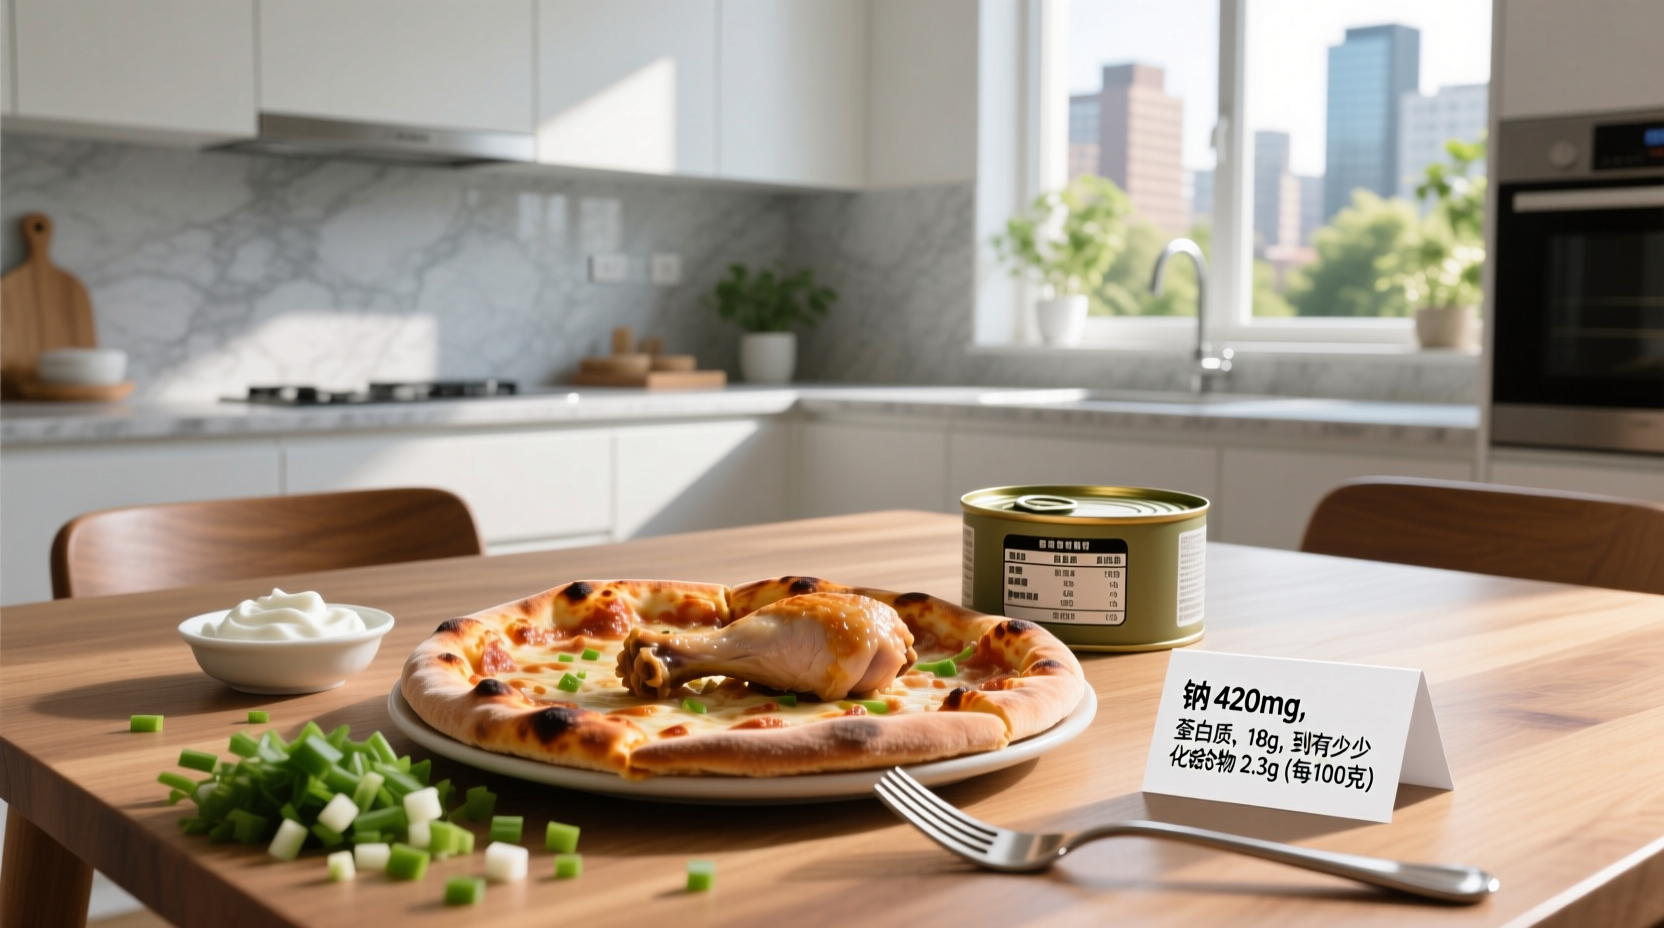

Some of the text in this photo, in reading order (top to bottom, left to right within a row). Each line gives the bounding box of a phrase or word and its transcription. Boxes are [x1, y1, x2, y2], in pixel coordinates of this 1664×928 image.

[1182, 678, 1307, 724] 钠 420mg,
[1248, 727, 1285, 756] 18g,
[1239, 754, 1281, 784] 2.3g
[1284, 758, 1375, 794] (每100克)
